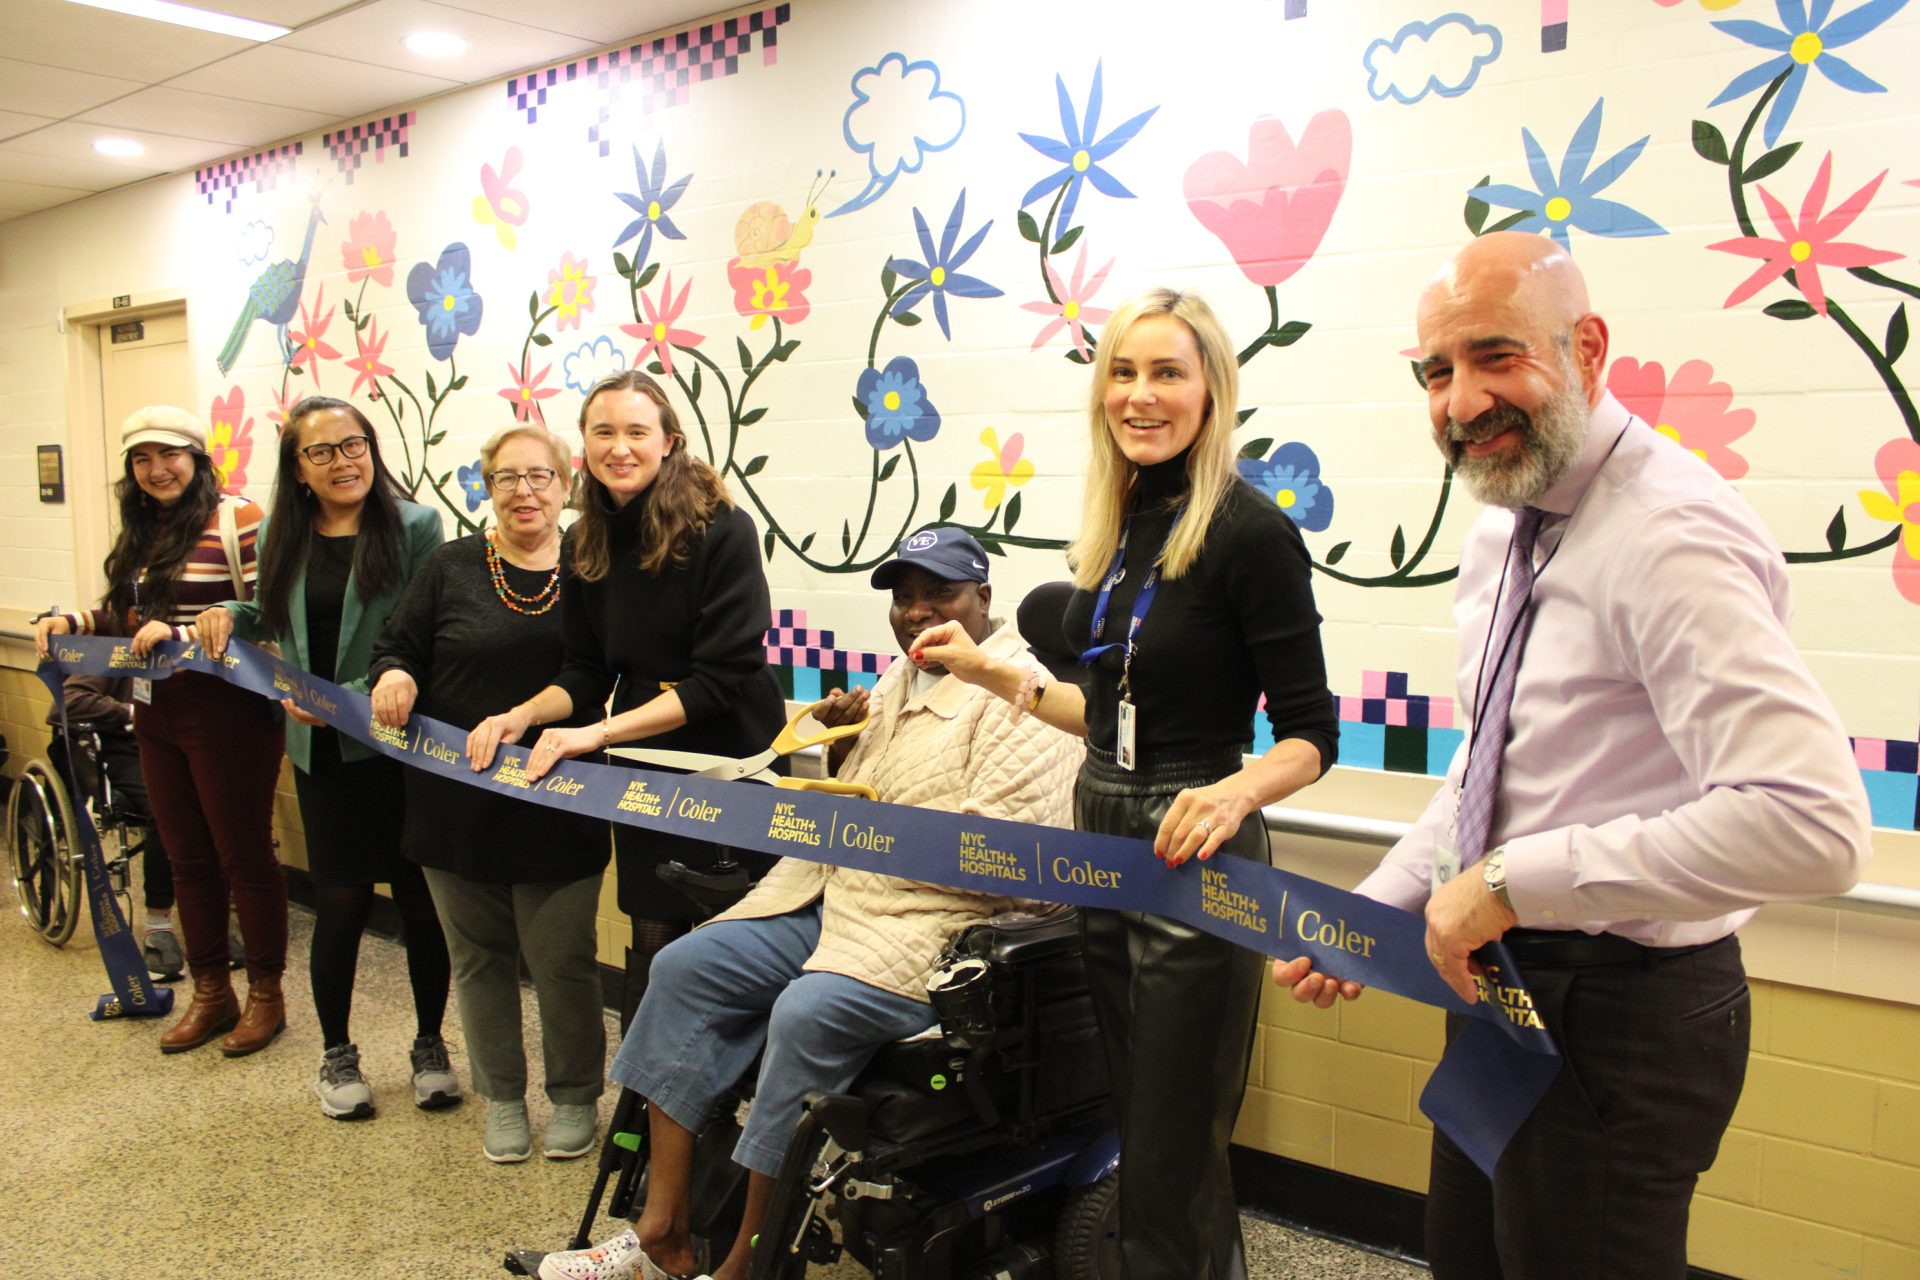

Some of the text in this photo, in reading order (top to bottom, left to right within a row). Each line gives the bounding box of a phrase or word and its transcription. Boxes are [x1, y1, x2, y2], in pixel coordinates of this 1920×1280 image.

[423, 737, 460, 765] Coler
[503, 755, 521, 768] NYC
[546, 776, 585, 796] Coler
[628, 780, 647, 792] NYC
[622, 790, 661, 805] HEALTH+
[616, 799, 662, 817] HOSPITALS
[678, 797, 722, 823] Coler
[774, 802, 795, 815] NYC
[771, 815, 817, 832] HEALTH+
[767, 826, 821, 846] HOSPITALS
[842, 823, 895, 853] Coler
[960, 831, 986, 848] NYC
[959, 846, 1017, 866] HEALTH+
[959, 859, 1027, 881] HOSPITALS
[1052, 857, 1122, 889] Coler
[1201, 867, 1228, 888] NYC
[1201, 883, 1260, 914] HEALTH+
[1202, 897, 1268, 934] HOSPITALS
[1296, 910, 1377, 959] Coler
[127, 975, 147, 1006] Coler
